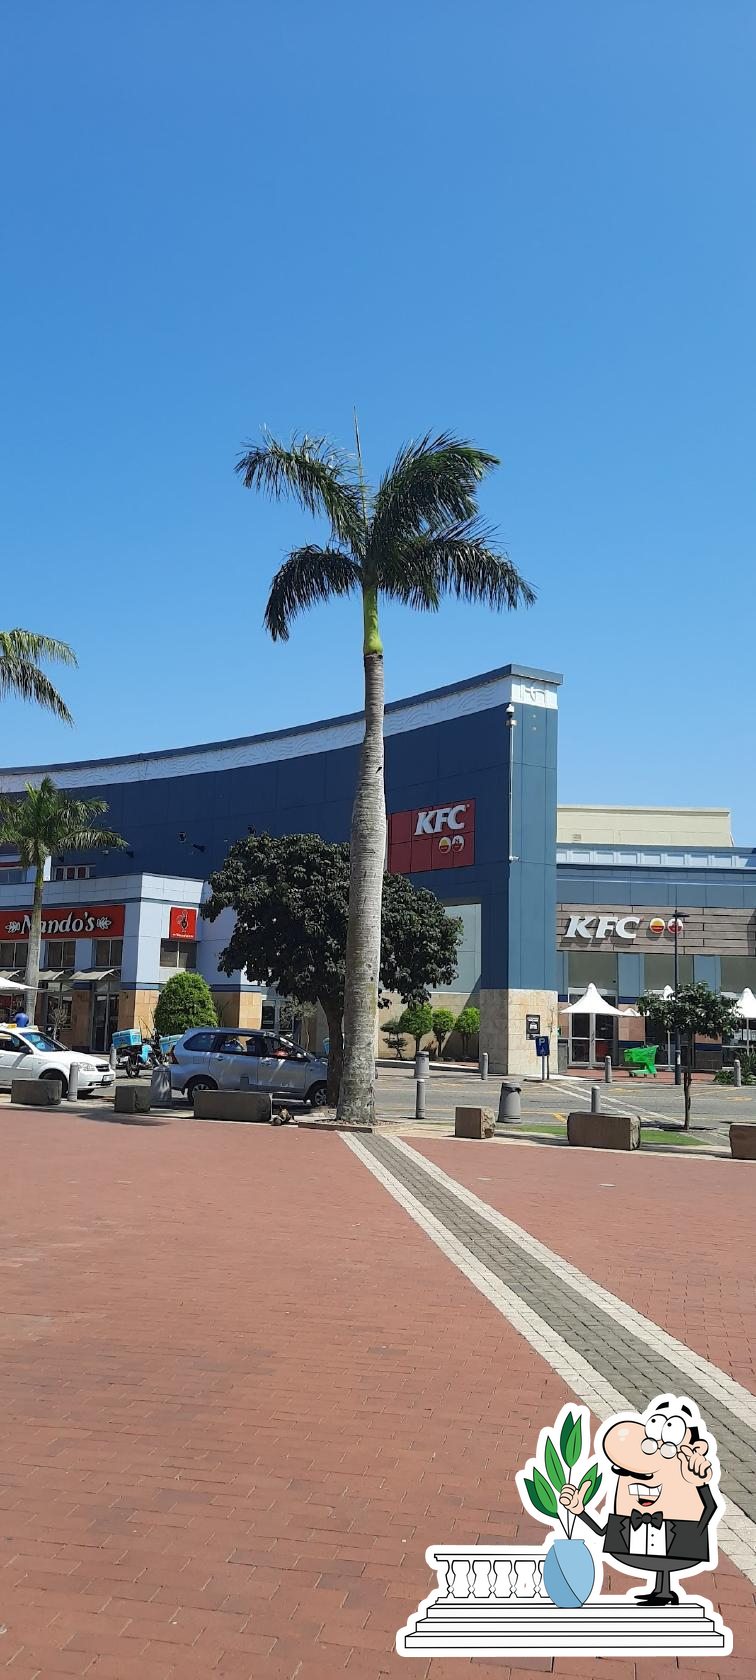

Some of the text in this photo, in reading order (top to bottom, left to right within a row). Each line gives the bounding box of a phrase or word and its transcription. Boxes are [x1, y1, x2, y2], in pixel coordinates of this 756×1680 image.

[414, 804, 466, 835] KFC
[565, 915, 640, 939] KFC
[538, 1037, 546, 1046] P
